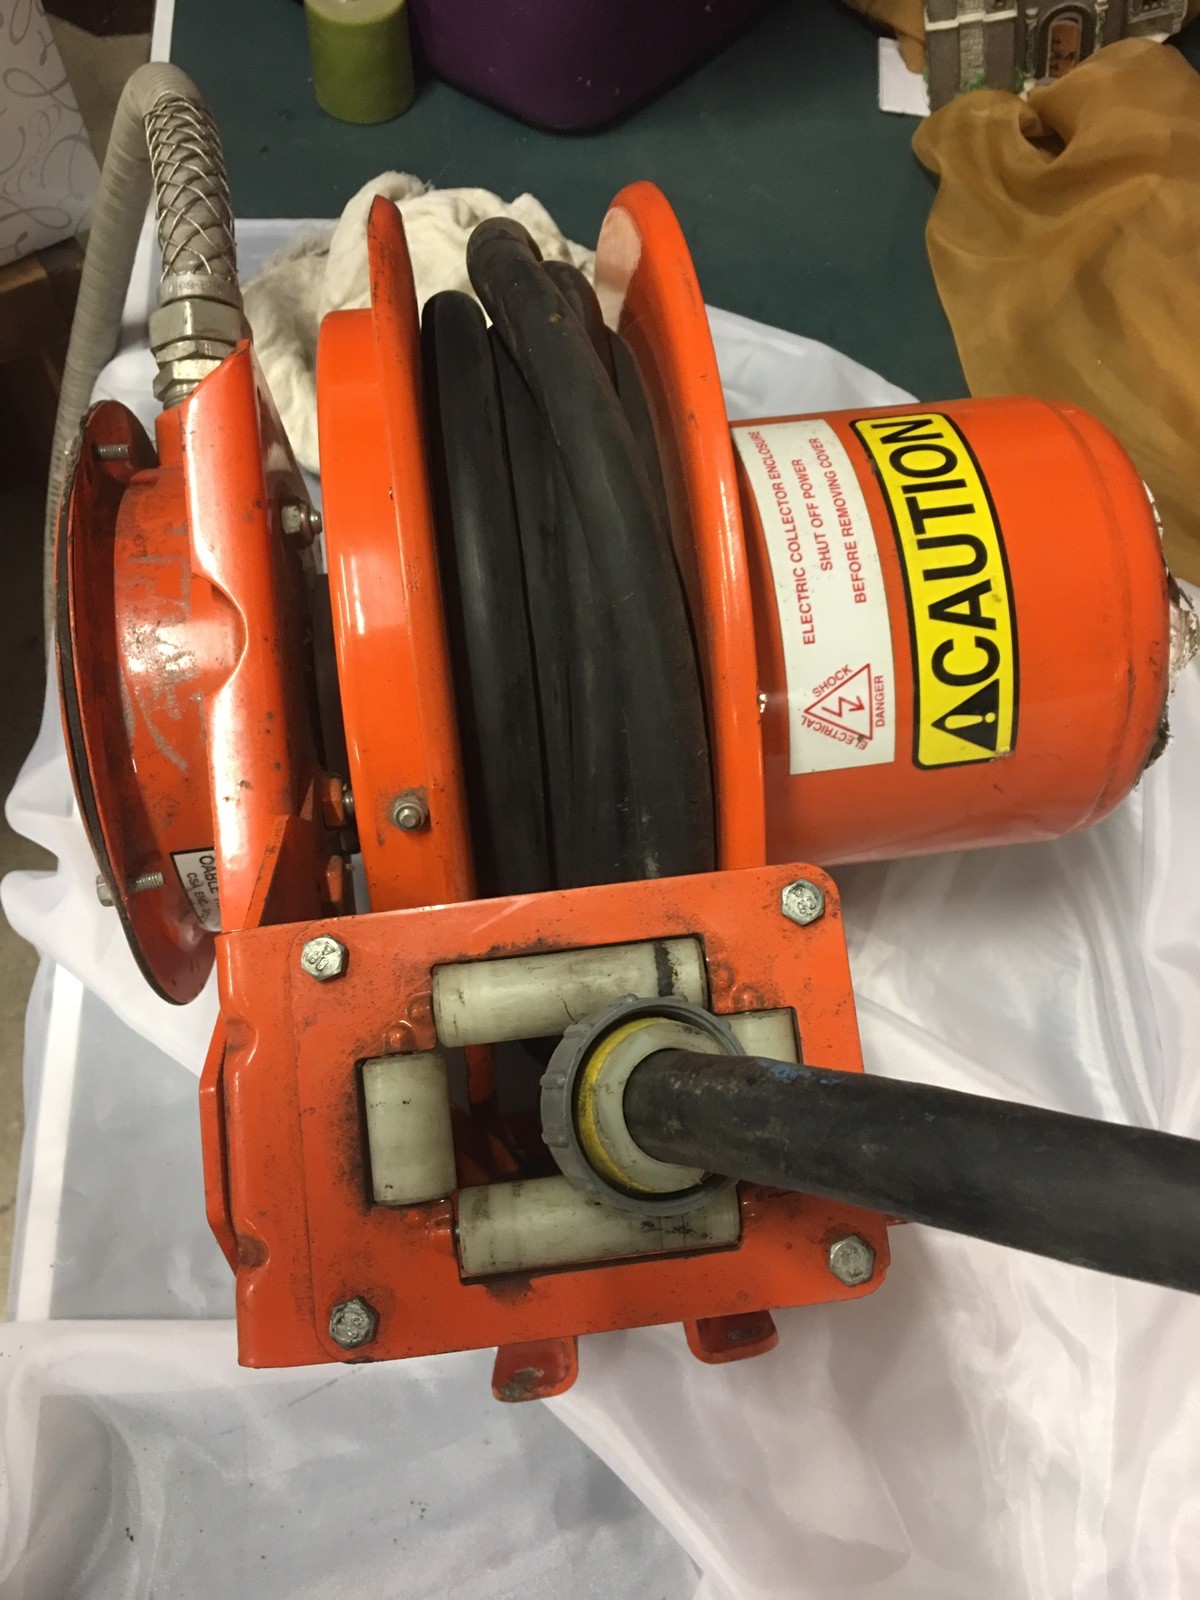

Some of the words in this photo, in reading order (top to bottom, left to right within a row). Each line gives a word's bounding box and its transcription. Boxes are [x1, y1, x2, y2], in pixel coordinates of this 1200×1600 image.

[748, 430, 782, 480] ENCLOSURE
[809, 438, 832, 468] COVER
[791, 459, 815, 500] POWER
[773, 486, 803, 563] COLLECTOR
[806, 502, 824, 529] OFF
[824, 471, 855, 537] REMOVING
[814, 532, 833, 571] SHUT
[844, 541, 867, 604] BEFORE
[871, 419, 1000, 687] CAUTION
[793, 568, 816, 645] ELECTRIC
[812, 664, 853, 698] SHOCK
[874, 675, 885, 727] DANGER
[801, 715, 868, 750] ELECTRICAL
[187, 872, 199, 890] CSA
